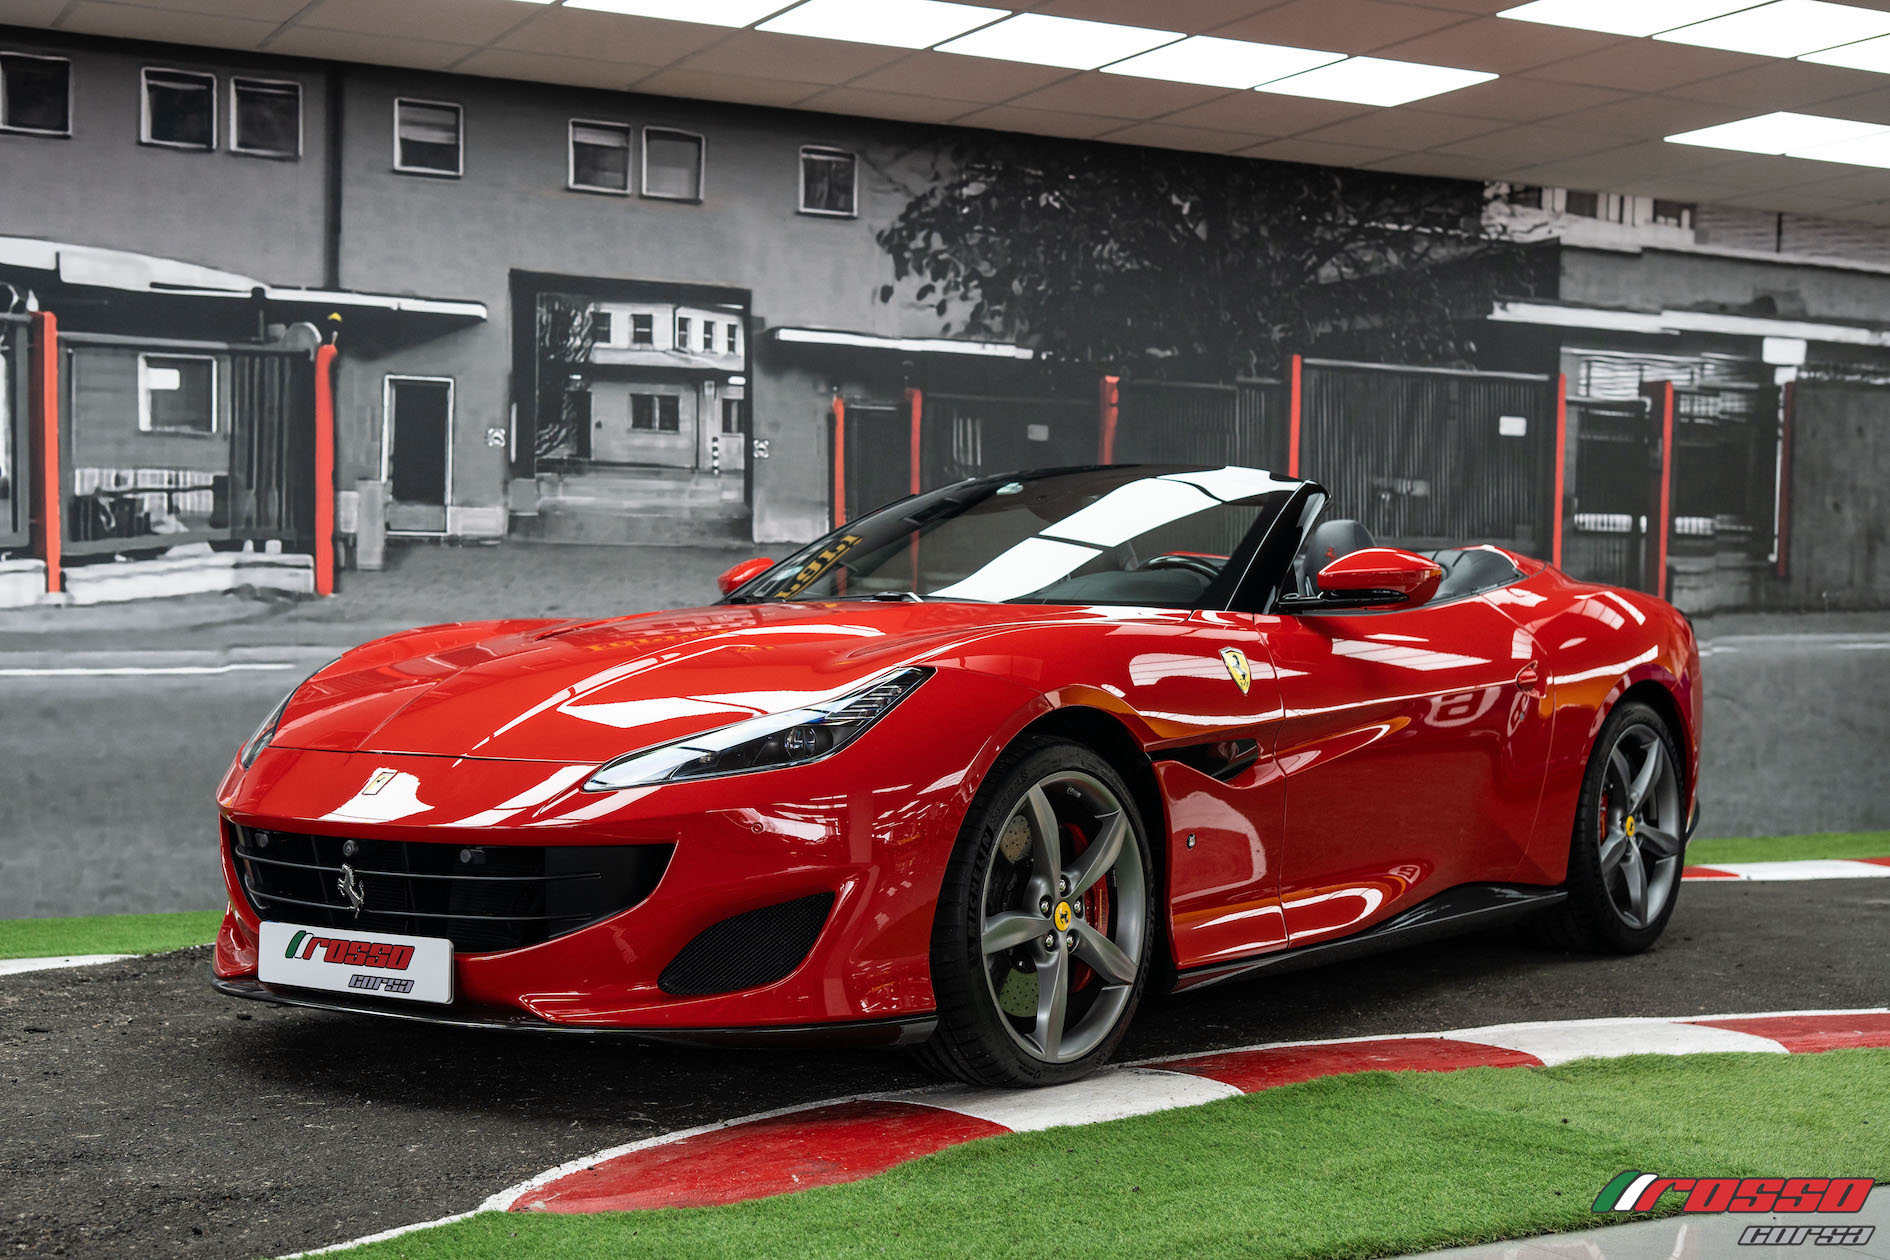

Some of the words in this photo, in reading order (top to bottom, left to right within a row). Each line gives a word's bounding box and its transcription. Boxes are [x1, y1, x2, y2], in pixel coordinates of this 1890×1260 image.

[969, 832, 992, 937] MICHELIN
[303, 936, 415, 970] rosso
[349, 974, 415, 993] corsa
